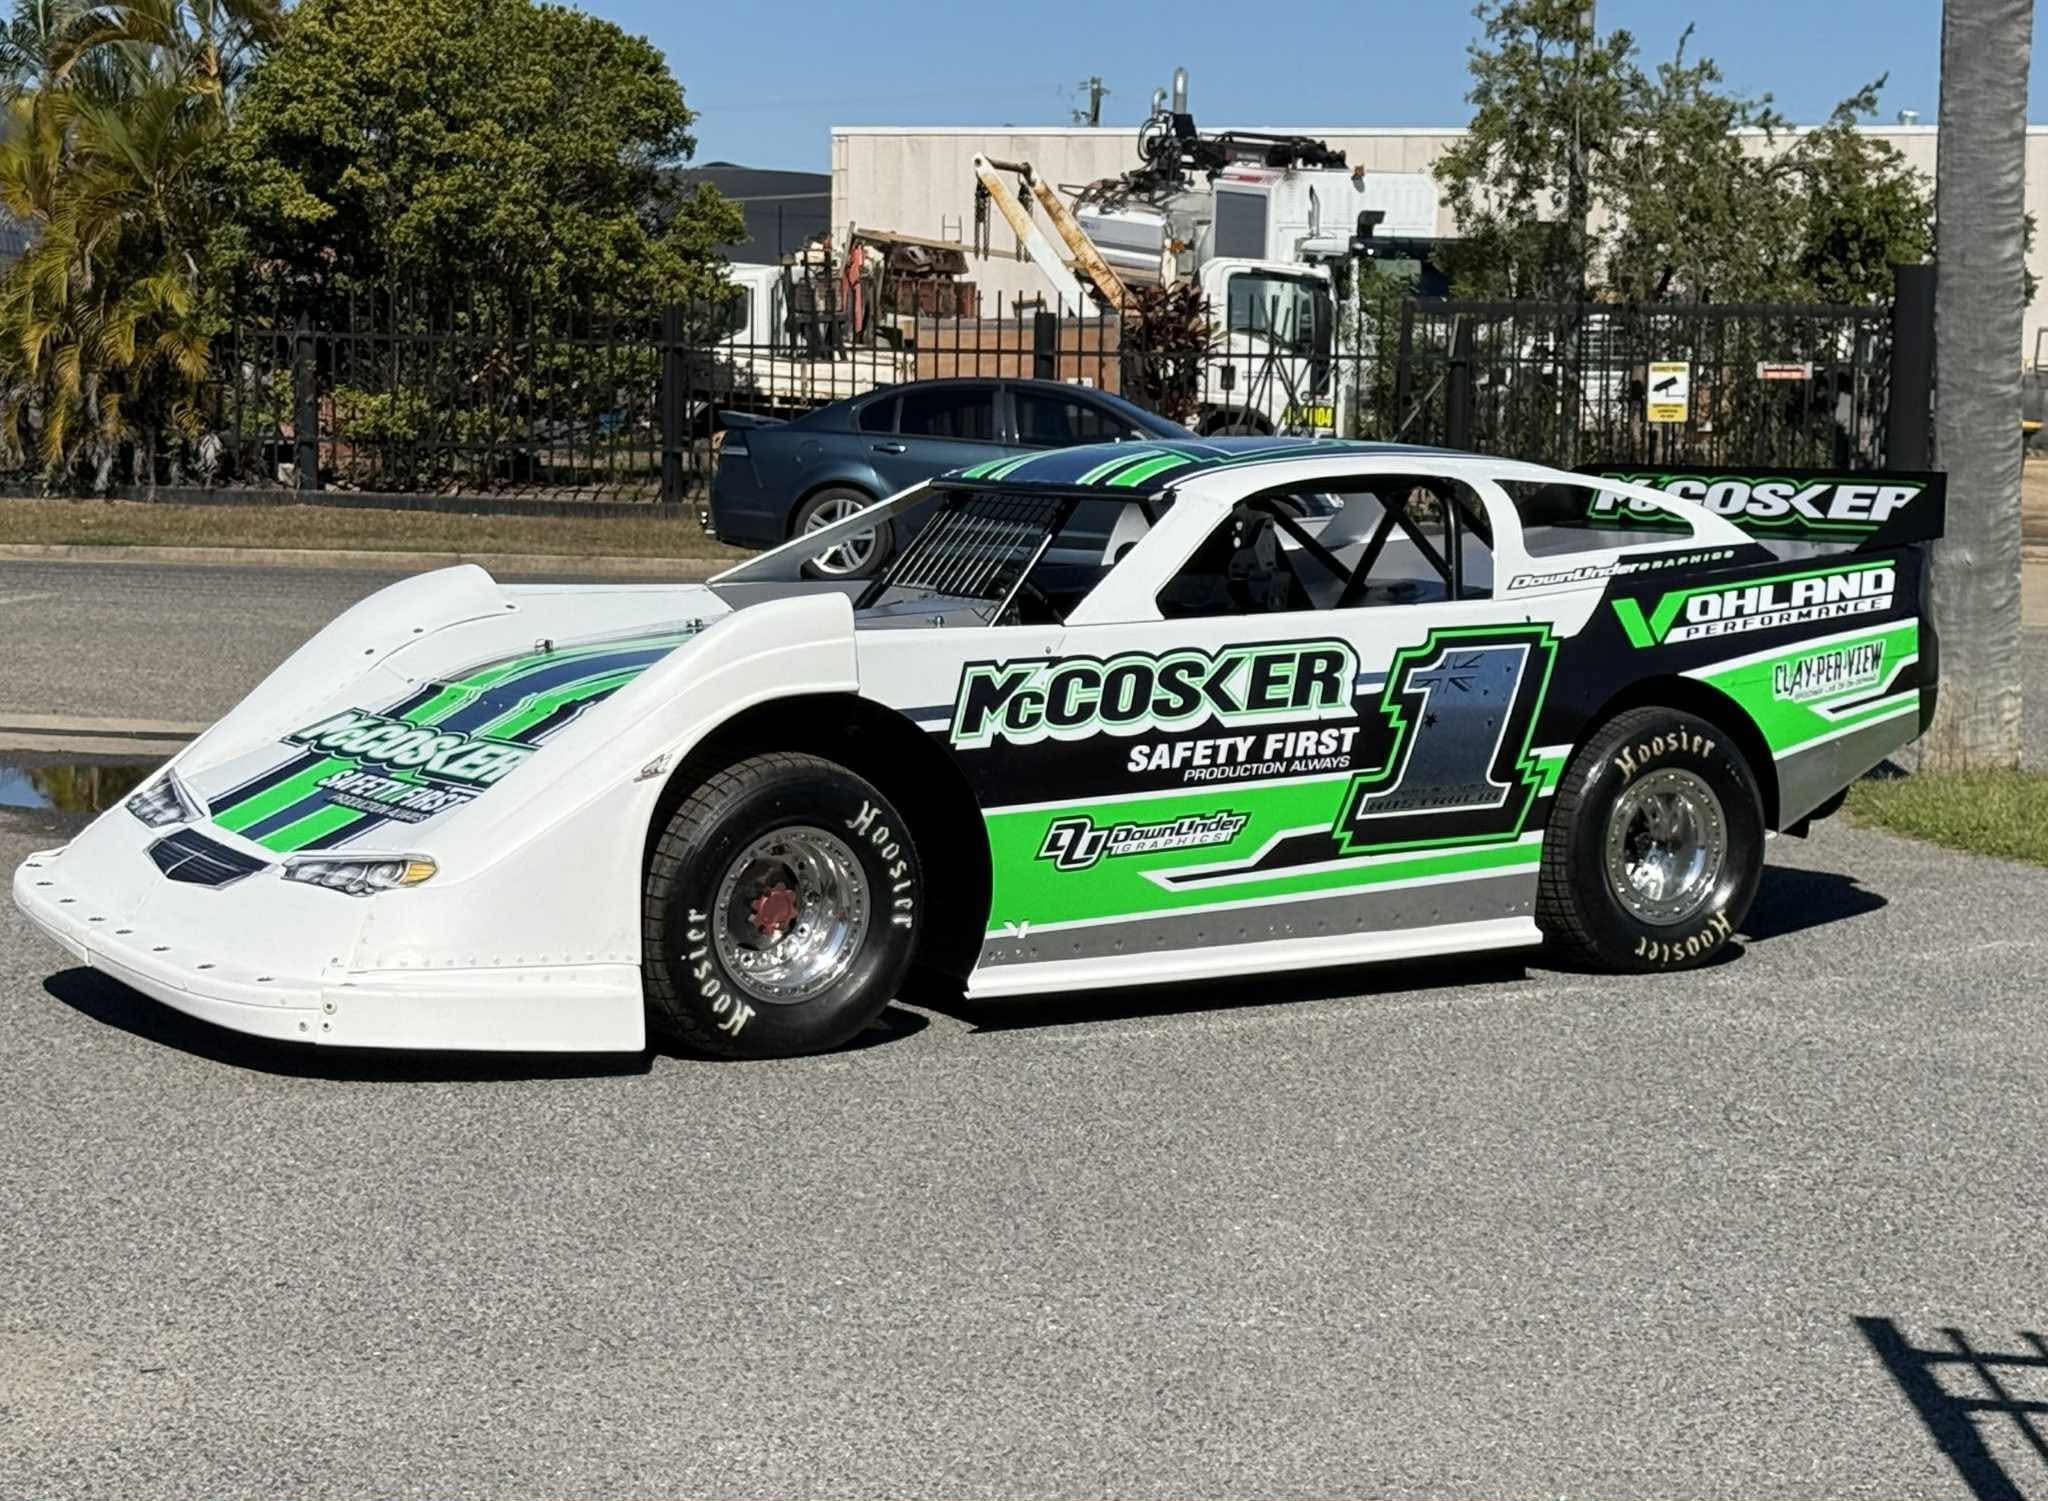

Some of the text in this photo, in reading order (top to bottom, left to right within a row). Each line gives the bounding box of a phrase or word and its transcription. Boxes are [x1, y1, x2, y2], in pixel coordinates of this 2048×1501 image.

[1611, 568, 1896, 648] VOHLAND
[1685, 598, 1884, 639] PERFORMANCE
[956, 646, 1350, 738] McCOSKER
[1127, 727, 1361, 773] SAFETY FIRST
[1356, 642, 1530, 820] 1
[1614, 725, 1716, 783] Hoosier
[317, 769, 415, 803] SAFETY
[1183, 755, 1351, 783] PRODUCTION ALWAYS
[1111, 813, 1244, 844] DownUnder
[1121, 832, 1224, 853] GRAPHICS
[845, 800, 914, 930] Hoosier
[1634, 911, 1734, 968] Hoosier
[680, 908, 756, 1037] Hoosier
